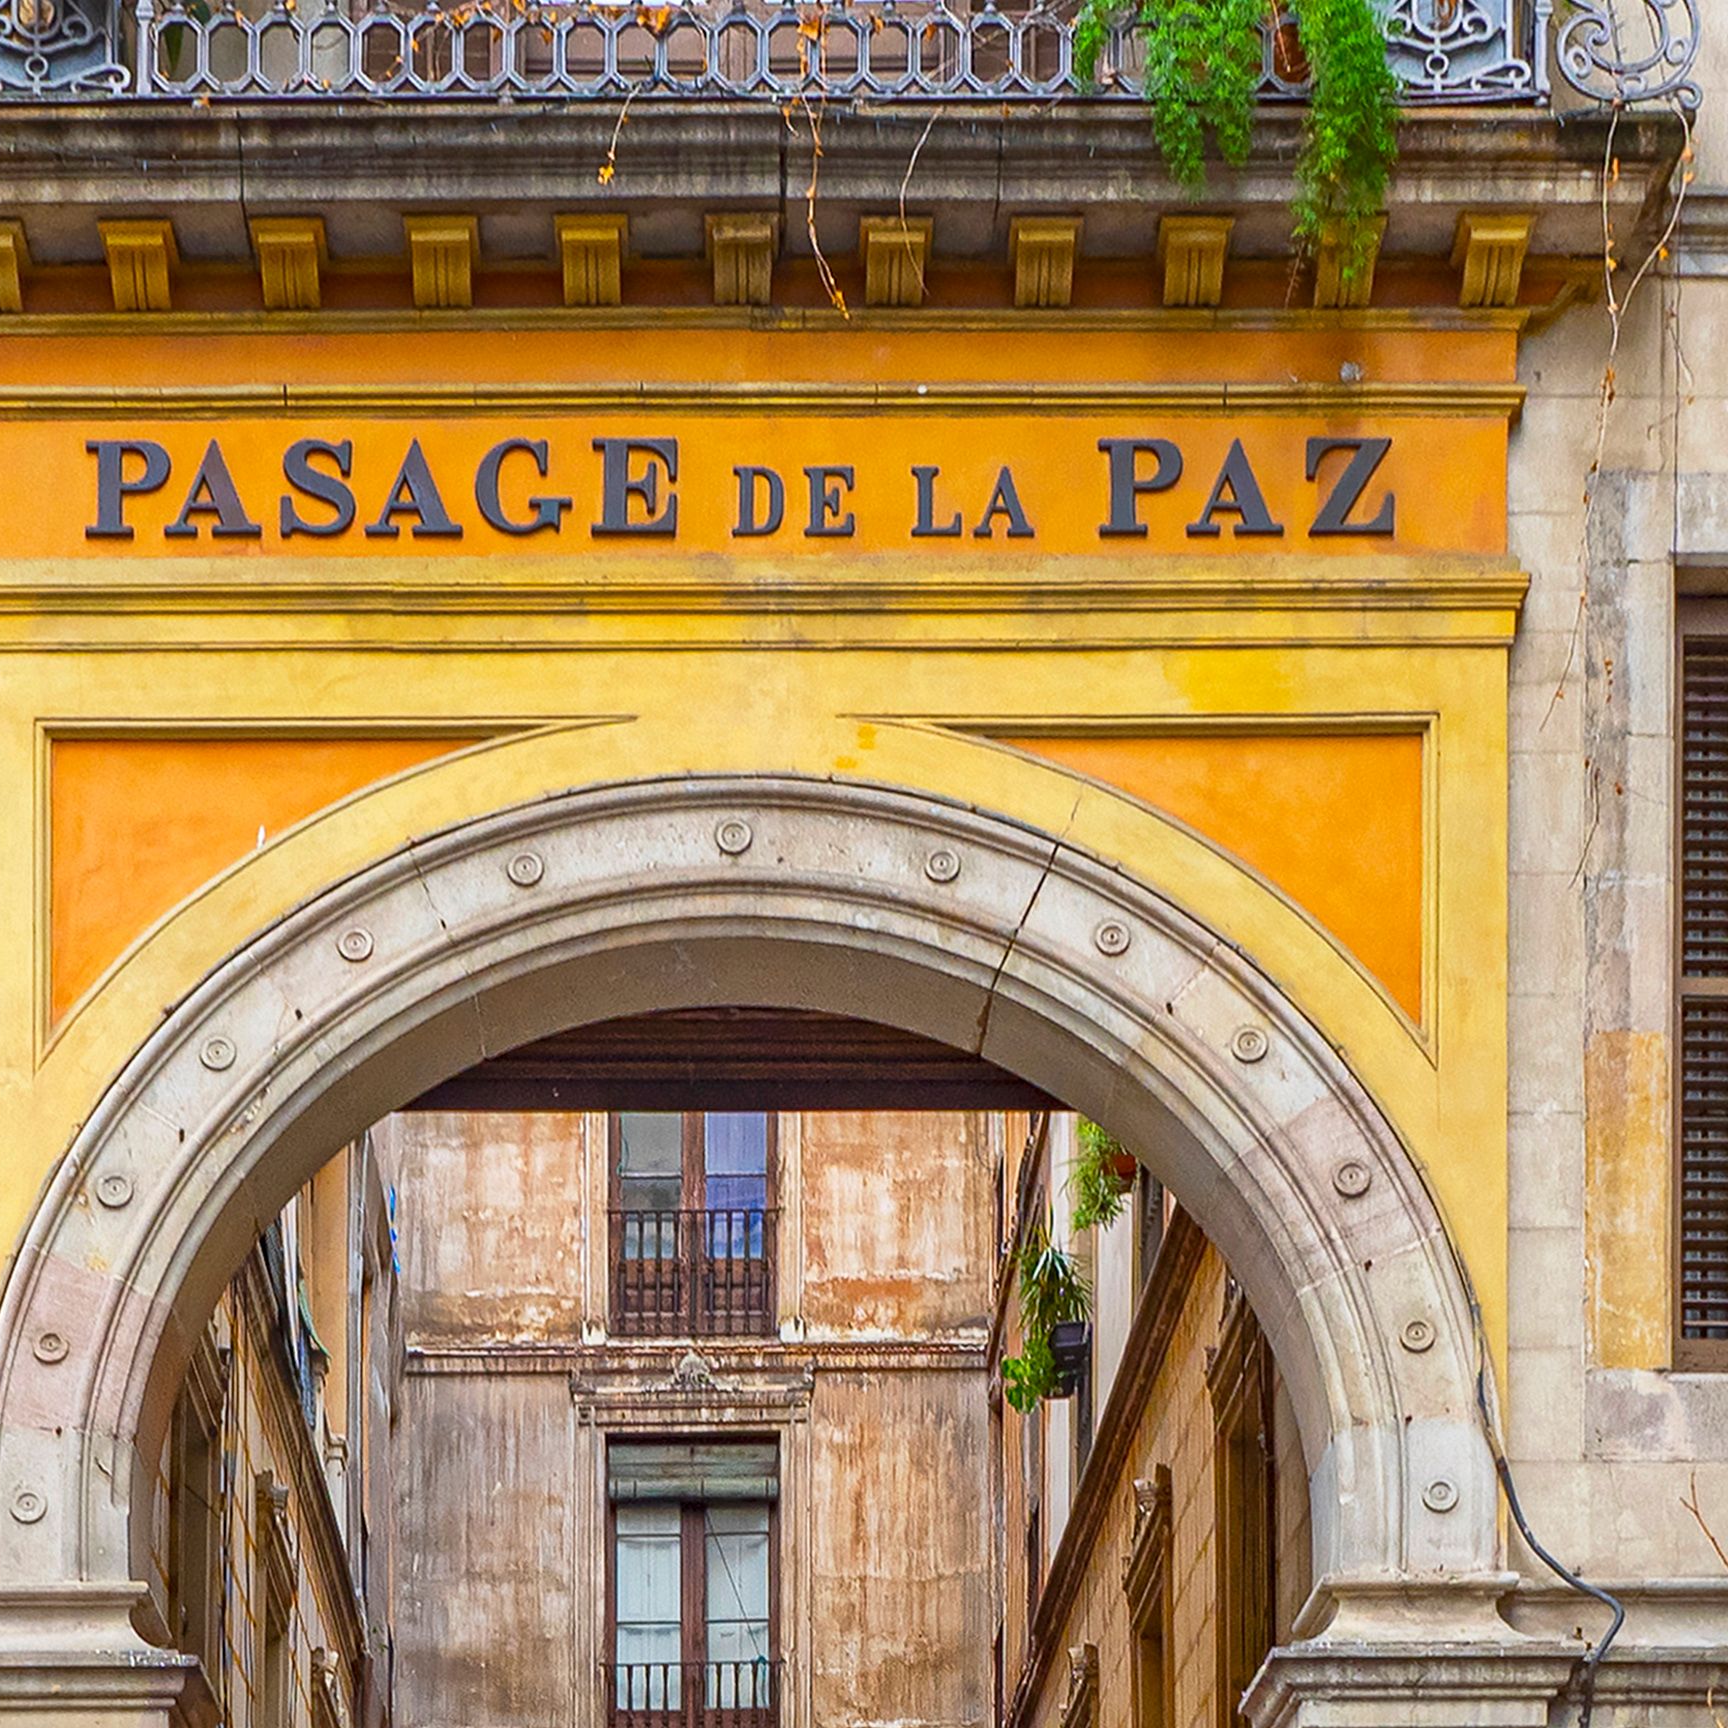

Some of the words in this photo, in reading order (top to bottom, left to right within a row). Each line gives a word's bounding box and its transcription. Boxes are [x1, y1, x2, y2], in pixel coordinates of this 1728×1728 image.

[84, 437, 680, 542] PASAGE
[730, 465, 857, 540] DE
[909, 465, 1036, 540] LA
[1096, 436, 1397, 541] PAZ
